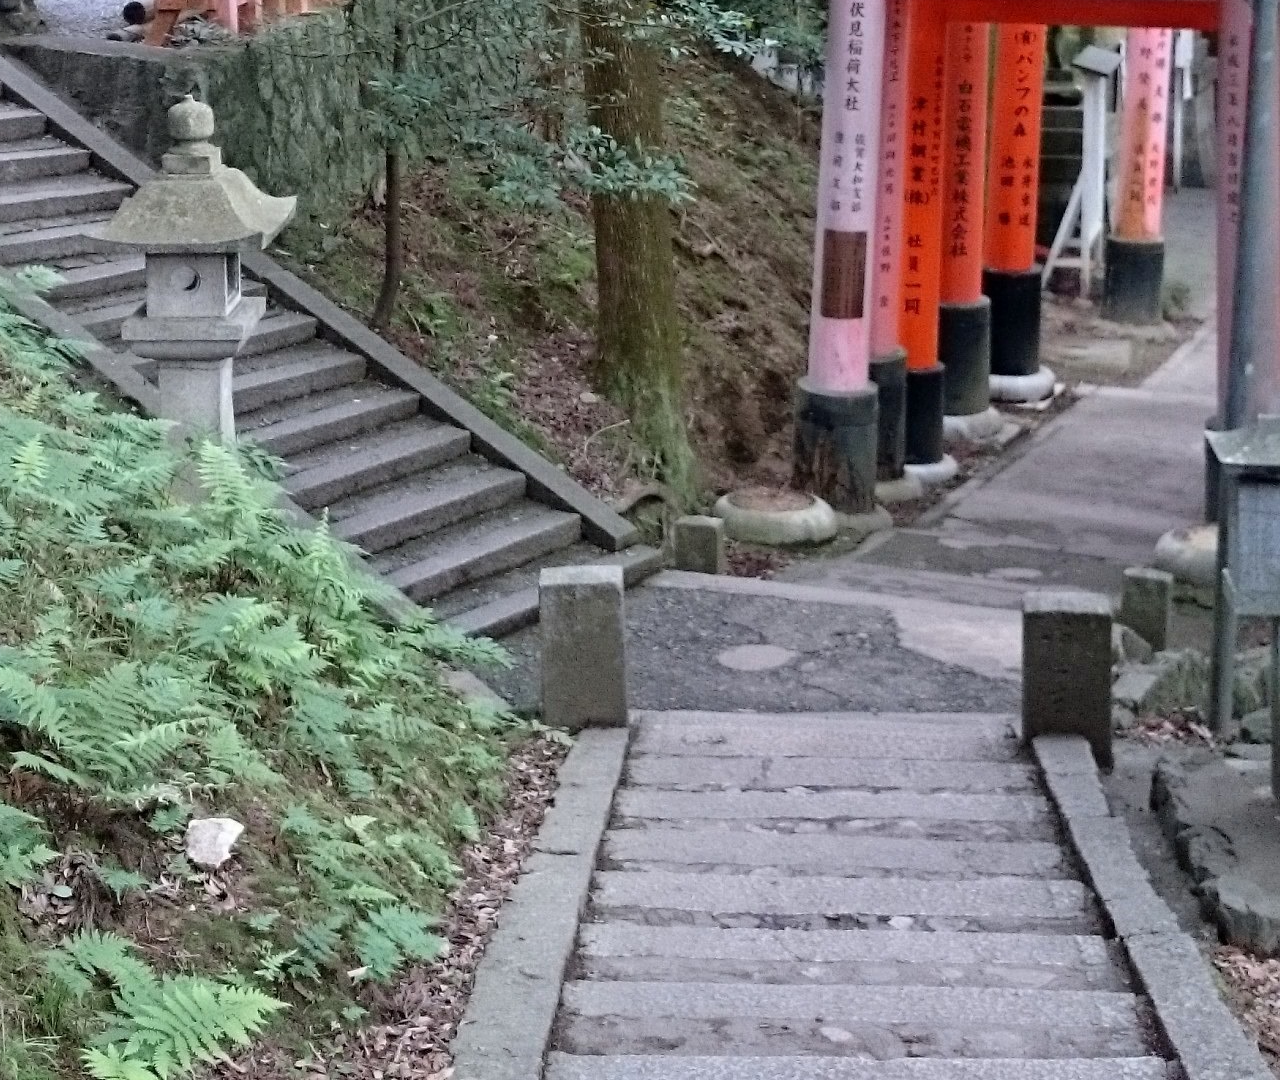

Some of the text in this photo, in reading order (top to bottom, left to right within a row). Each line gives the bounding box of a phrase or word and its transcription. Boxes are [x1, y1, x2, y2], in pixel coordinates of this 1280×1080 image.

[845, 1, 866, 112] 伏見稲荷大社
